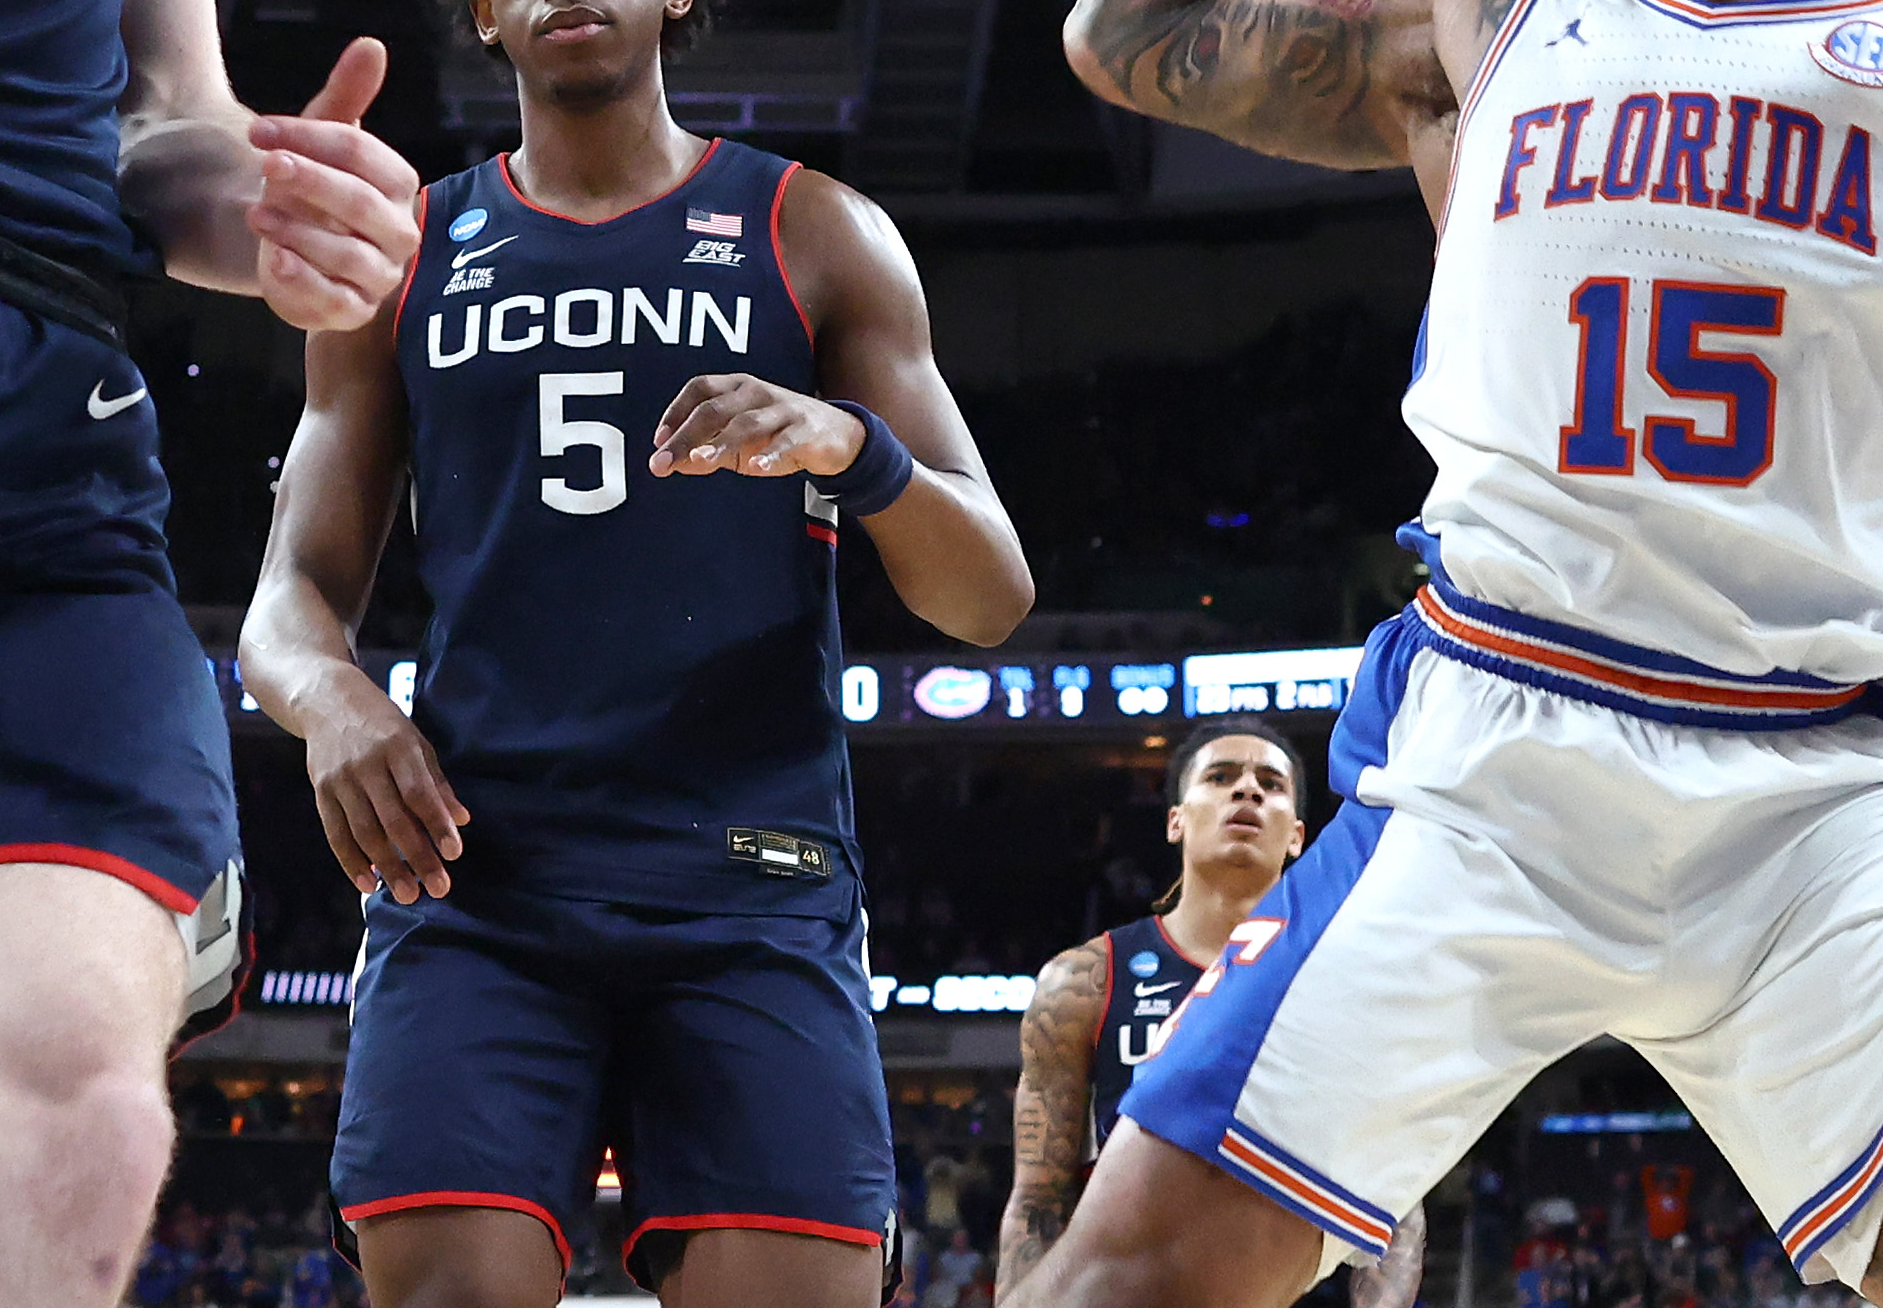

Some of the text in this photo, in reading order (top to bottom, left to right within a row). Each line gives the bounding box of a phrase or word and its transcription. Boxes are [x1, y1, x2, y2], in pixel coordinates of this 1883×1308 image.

[1493, 93, 1877, 256] FLORIDA
[694, 240, 736, 252] BIG
[688, 249, 746, 264] EAST
[468, 267, 495, 279] THE
[442, 277, 495, 296] CHANGE
[427, 288, 751, 369] UCONN
[1558, 277, 1786, 487] 15
[539, 371, 627, 516] 5
[802, 850, 820, 865] 48
